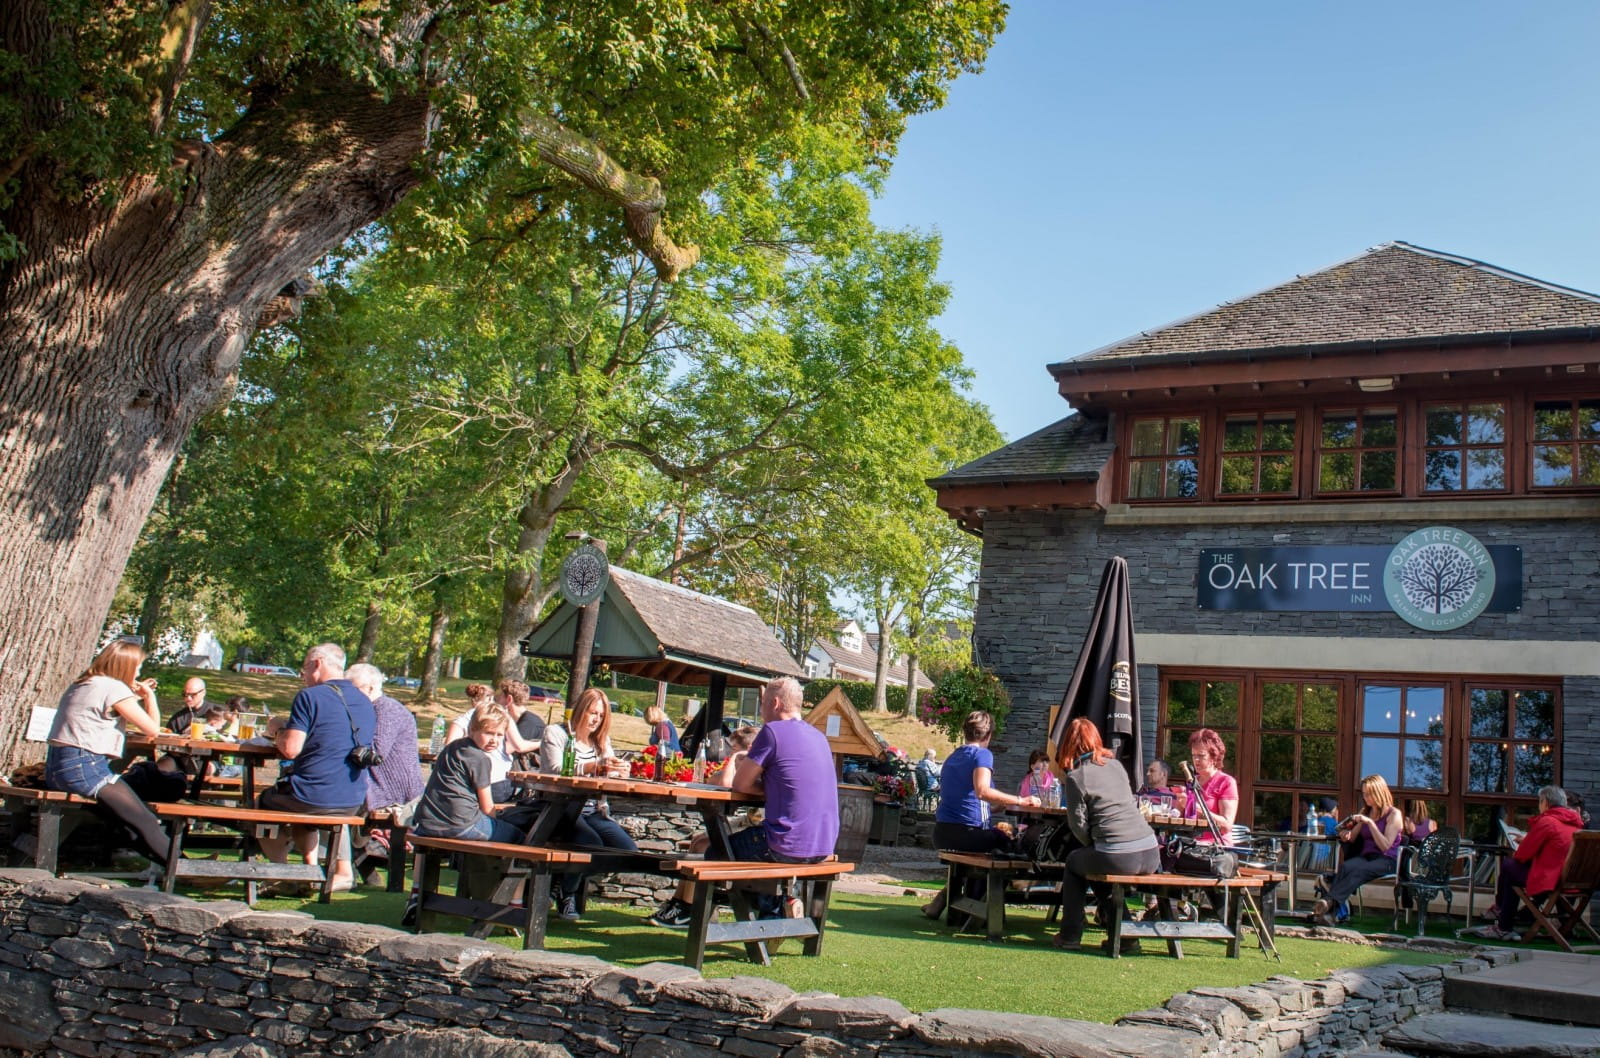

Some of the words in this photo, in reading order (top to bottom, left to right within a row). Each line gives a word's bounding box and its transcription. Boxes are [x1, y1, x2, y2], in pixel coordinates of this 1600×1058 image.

[1212, 553, 1234, 564] THE
[1391, 537, 1418, 566] OAK
[1421, 529, 1463, 544] TREE
[1464, 539, 1489, 565] INN
[1208, 563, 1278, 590] OAK
[1287, 562, 1371, 590] TREE
[1351, 593, 1372, 604] INN
[1431, 617, 1456, 627] LOCH
[1459, 592, 1486, 621] LOMOND
